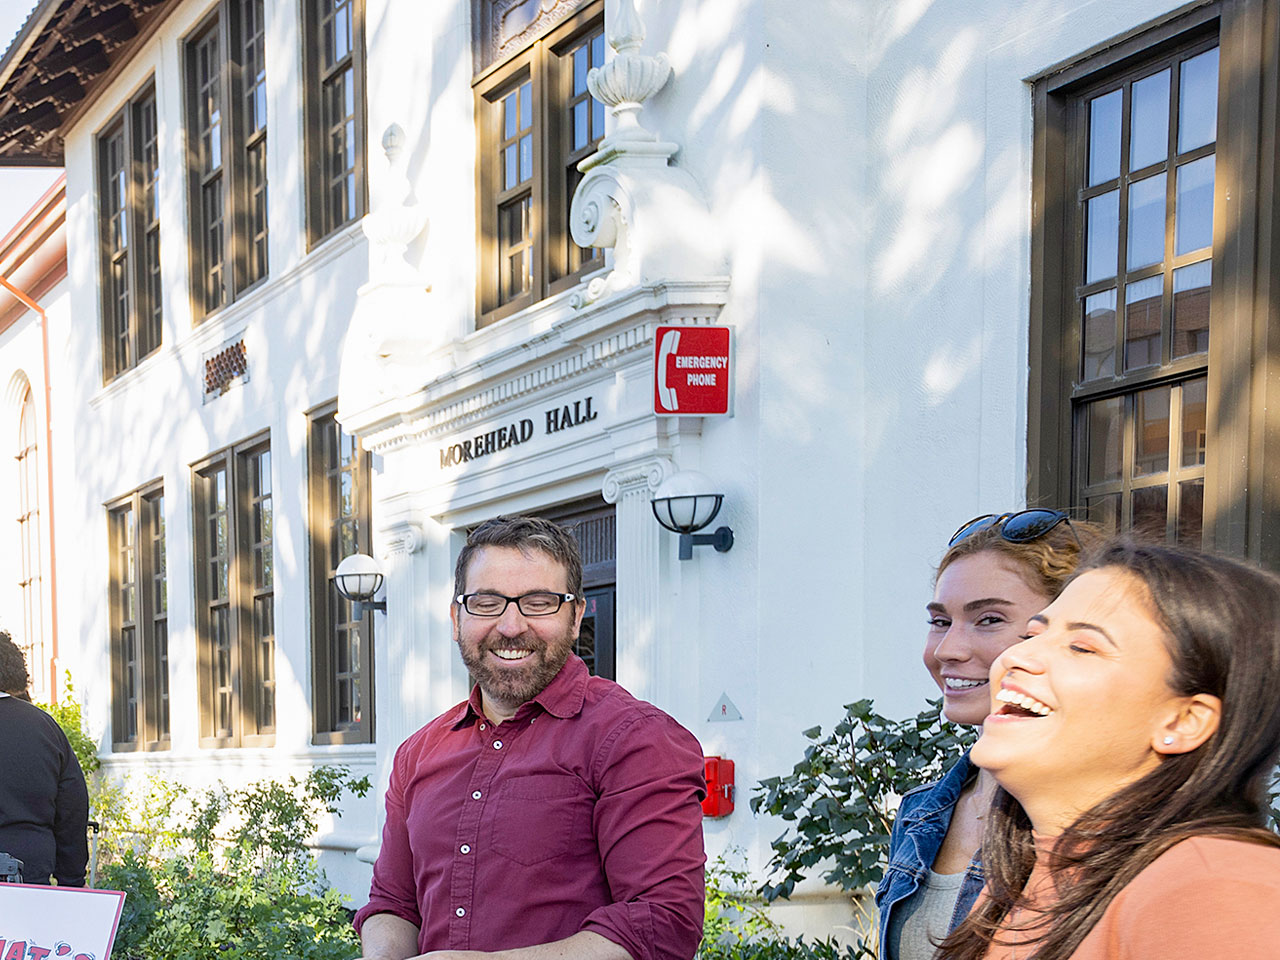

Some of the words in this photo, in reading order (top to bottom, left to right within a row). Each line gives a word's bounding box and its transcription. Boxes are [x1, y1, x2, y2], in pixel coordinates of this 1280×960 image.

[675, 355, 728, 369] EMERGENCY
[687, 373, 717, 386] PHONE
[439, 418, 534, 470] MOREHEAD
[545, 397, 598, 435] HALL
